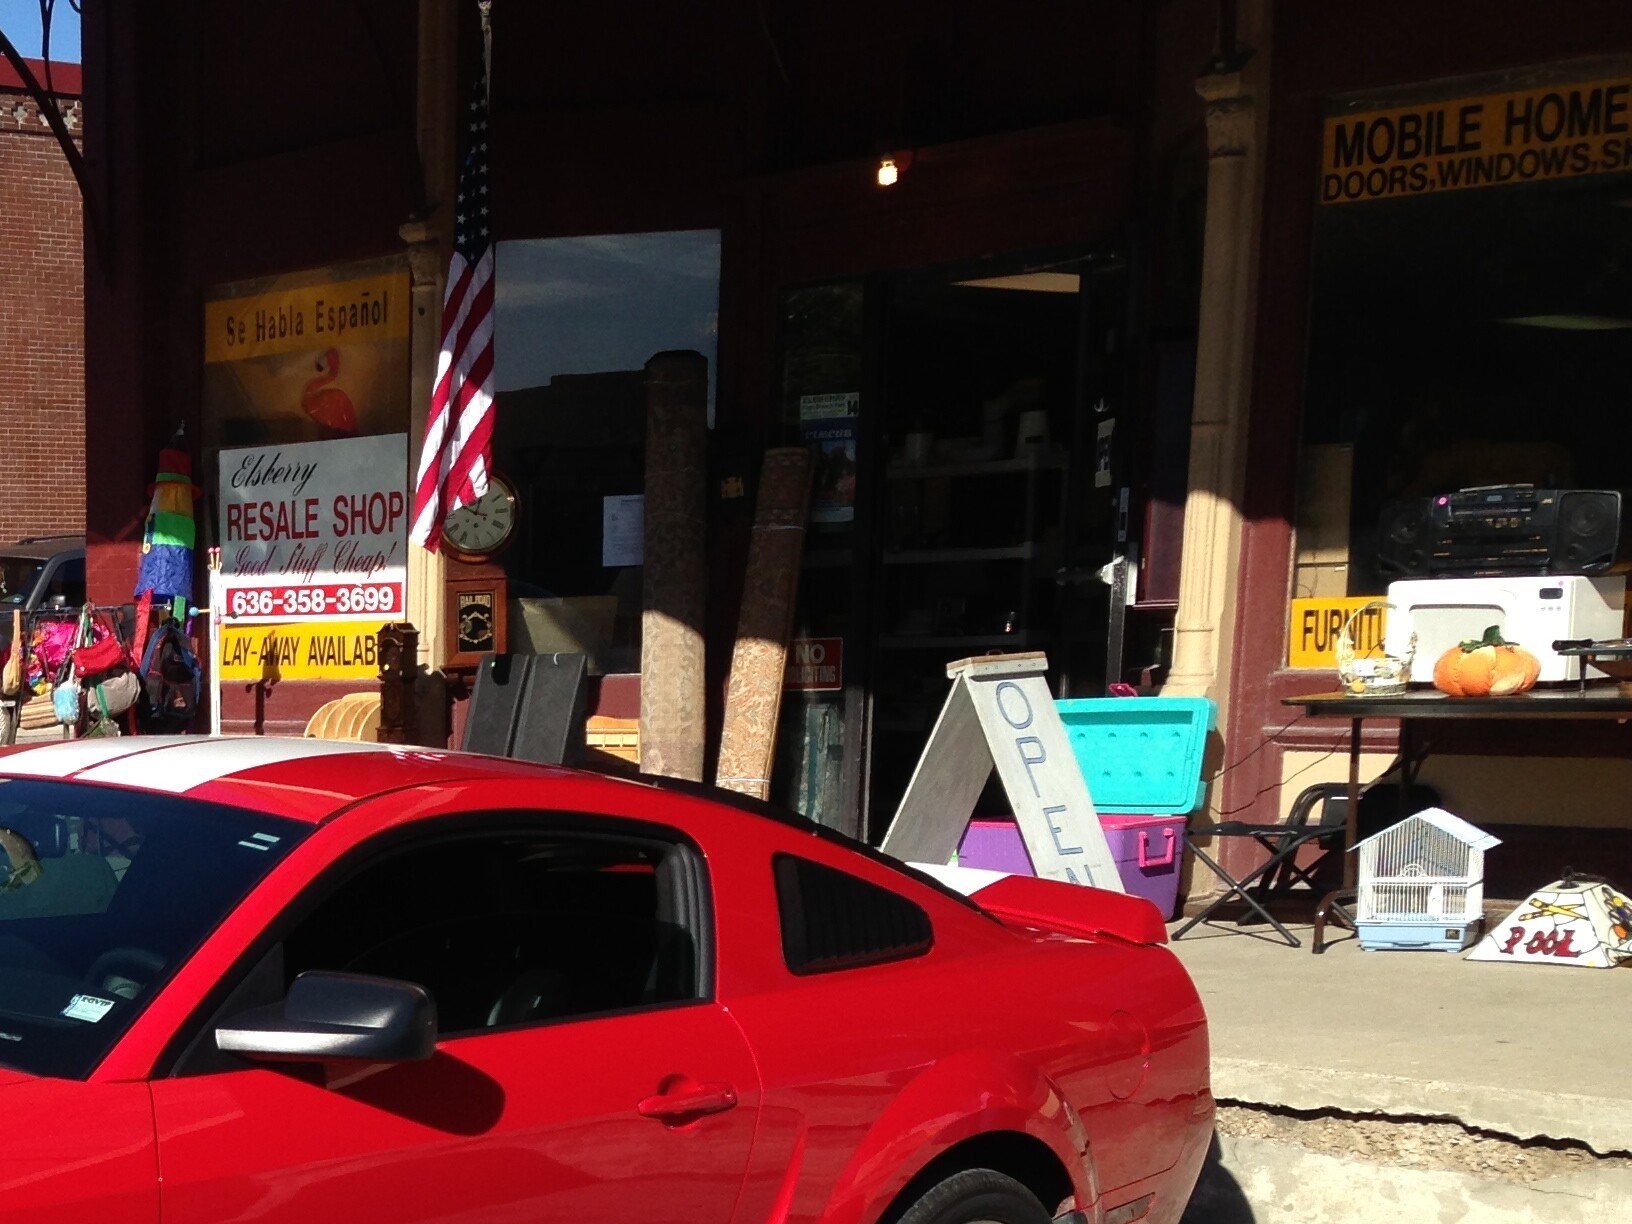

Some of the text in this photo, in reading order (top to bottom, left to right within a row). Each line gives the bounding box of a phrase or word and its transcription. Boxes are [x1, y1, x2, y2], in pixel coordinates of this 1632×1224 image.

[1333, 105, 1483, 168] MOBILE
[226, 291, 388, 346] Se Habla Español
[231, 453, 318, 496] Elsberry
[227, 491, 404, 542] RESALE SHOP
[233, 539, 398, 584] Good Stuff Cheap!
[232, 586, 394, 614] 636-358-3699
[222, 635, 378, 667] LAY-AWAY AVAILAB
[796, 644, 825, 664] NO
